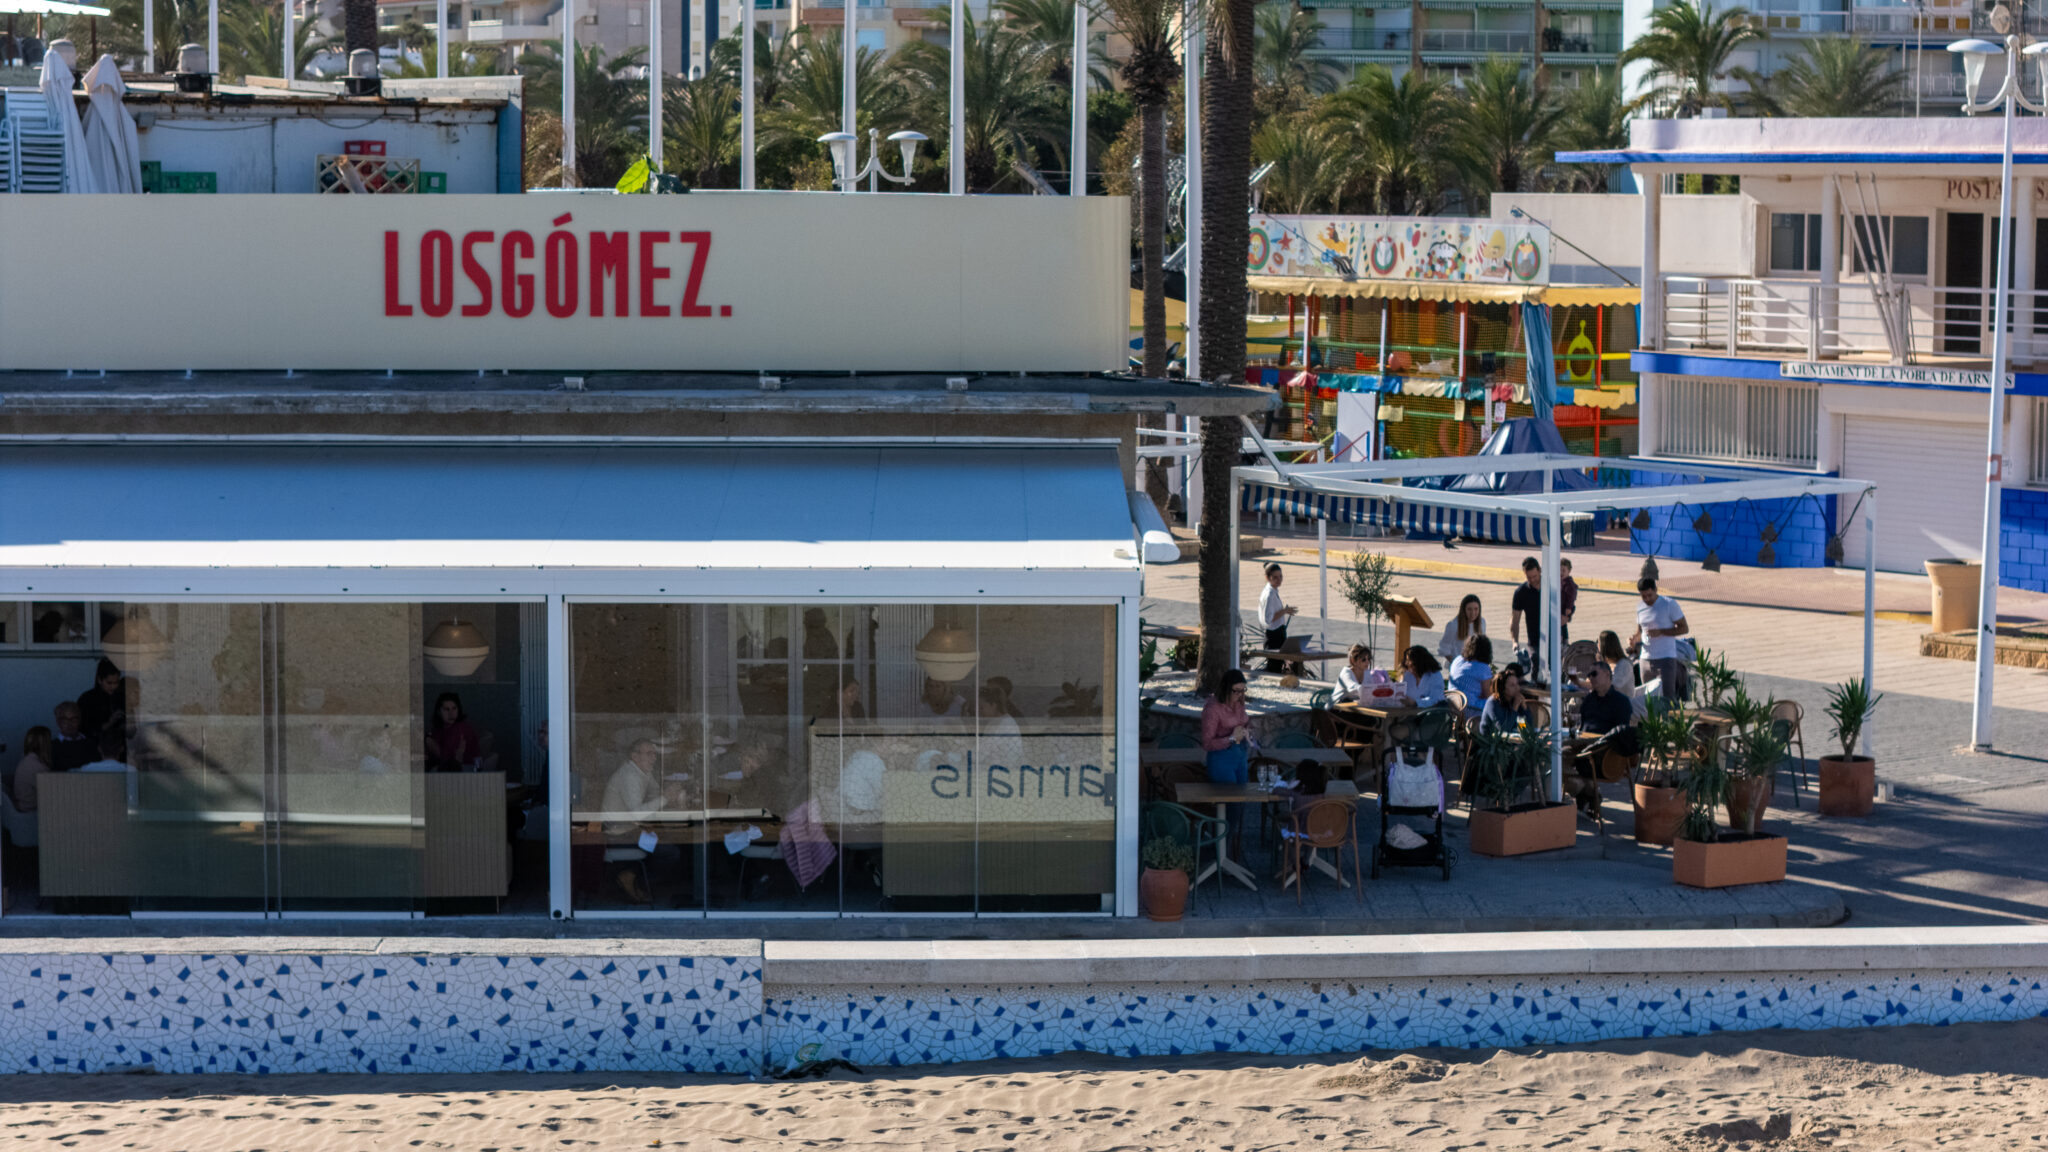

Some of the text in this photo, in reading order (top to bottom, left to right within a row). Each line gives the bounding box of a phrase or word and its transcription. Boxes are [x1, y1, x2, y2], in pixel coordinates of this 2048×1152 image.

[385, 212, 732, 318] LOSGÓMEZ.
[1791, 364, 2013, 386] AJUNTAMENT DE LA POBLA DE FARNS
